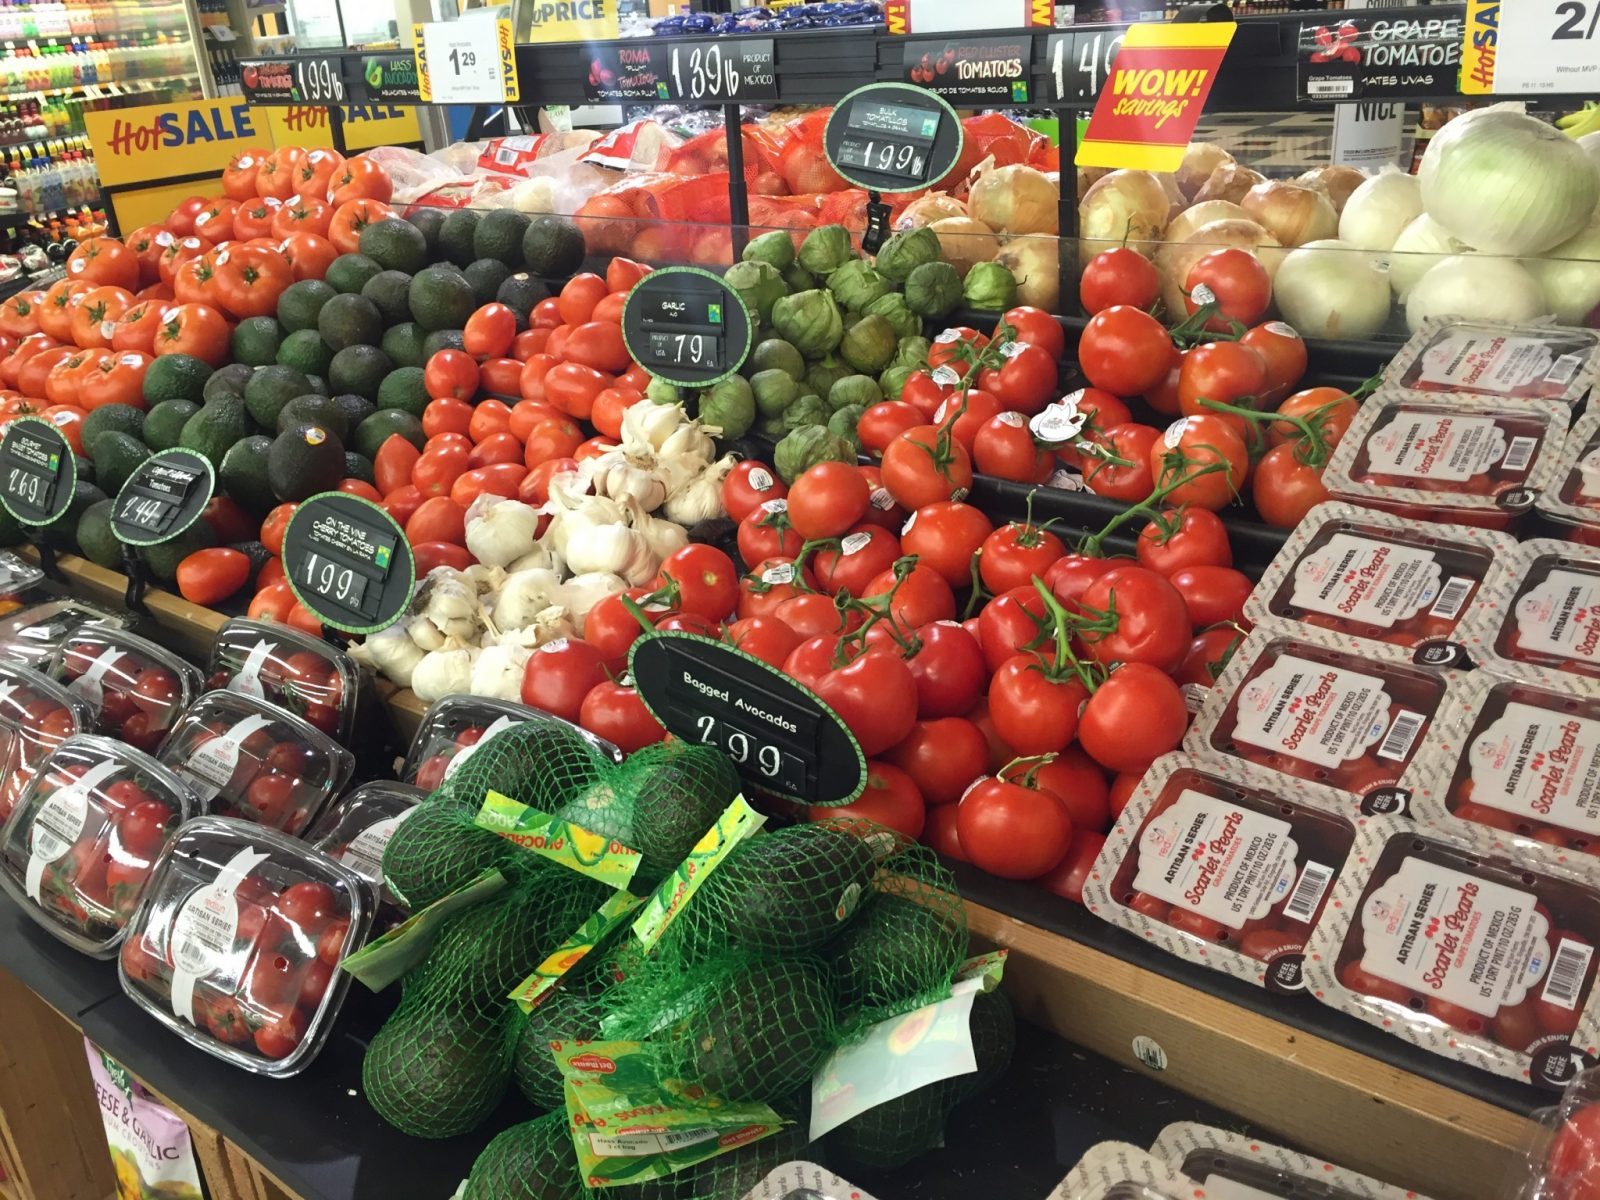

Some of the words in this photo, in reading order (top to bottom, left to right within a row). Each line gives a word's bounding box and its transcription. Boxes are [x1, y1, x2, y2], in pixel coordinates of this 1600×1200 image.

[1370, 20, 1461, 42] GRAPE
[618, 49, 651, 64] ROMA
[743, 53, 771, 63] PRODUCT
[752, 64, 762, 74] OF
[955, 58, 1023, 80] TOMATOES
[1556, 66, 1581, 74] Without
[1581, 65, 1598, 73] MVP
[744, 74, 774, 86] MEXICO
[1113, 69, 1208, 97] WOW!
[1400, 75, 1435, 86] UVAS
[1113, 97, 1189, 130] savings
[661, 301, 686, 311] GARLIC
[655, 349, 666, 357] USA
[312, 520, 339, 538] CHERRY
[339, 530, 376, 555] TOMATOES
[337, 520, 351, 533] THE
[350, 526, 367, 540] VINE
[1319, 571, 1343, 600] ARTISAN
[1337, 549, 1358, 573] SERIES
[1337, 579, 1370, 614] Scarlet
[1360, 546, 1391, 579] Pearls
[1374, 587, 1391, 609] PRODUCT
[1392, 562, 1408, 580] MEXICO
[1549, 610, 1570, 642] ARTISAN
[1563, 586, 1583, 612] SERIES
[683, 670, 730, 702] Bagged
[735, 697, 798, 734] Avocados
[1262, 701, 1286, 734] ARTISAN
[1281, 673, 1304, 701] SERIES
[1281, 708, 1316, 750] Scarlet
[1305, 671, 1338, 708] Pearls
[1320, 719, 1339, 746] PRODUCT
[1334, 709, 1344, 721] OF
[1339, 691, 1357, 711] MEXICO
[1327, 746, 1338, 755] US
[1335, 732, 1347, 745] DRY
[1504, 755, 1527, 796] ARTISAN
[1519, 723, 1539, 756] SERIES
[1531, 765, 1564, 815] Scarlet
[1549, 720, 1581, 765] Pearls
[1373, 794, 1385, 808] PEEL
[1379, 795, 1393, 810] HERE
[1576, 777, 1594, 808] PRODUCT
[1164, 843, 1191, 884] ARTISAN
[1186, 813, 1207, 846] SERIES
[1184, 856, 1220, 906] Scarlet
[1210, 811, 1244, 856] Pearls
[1212, 866, 1227, 889] GRAPE
[1222, 836, 1243, 868] TOMATOES
[1244, 836, 1263, 863] MEXICO
[1240, 860, 1250, 873] OF
[1224, 871, 1245, 902] PRODUCT
[1231, 901, 1241, 913] US
[1239, 885, 1250, 901] DRY
[186, 904, 211, 921] ARTISAN
[1396, 920, 1421, 966] ARTISAN
[1414, 883, 1437, 921] SERIES
[1487, 910, 1506, 940] MEXICO
[1283, 944, 1303, 953] ENJOY
[1423, 933, 1460, 990] Scarlet
[1444, 882, 1480, 933] Pearls
[1454, 944, 1468, 969] GRAPE
[1462, 911, 1482, 947] TOMATOES
[1484, 938, 1493, 951] OF
[1277, 962, 1290, 979] PEEL
[1285, 963, 1299, 982] HERE
[1469, 949, 1489, 985] PRODUCT
[1479, 984, 1491, 1000] US
[1487, 966, 1499, 984] DRY
[1546, 1034, 1570, 1044] ENJOY
[1545, 1055, 1558, 1075] PEEL
[1553, 1056, 1569, 1078] HERE
[121, 1107, 130, 1126] &
[132, 1118, 180, 1161] GARLIC
